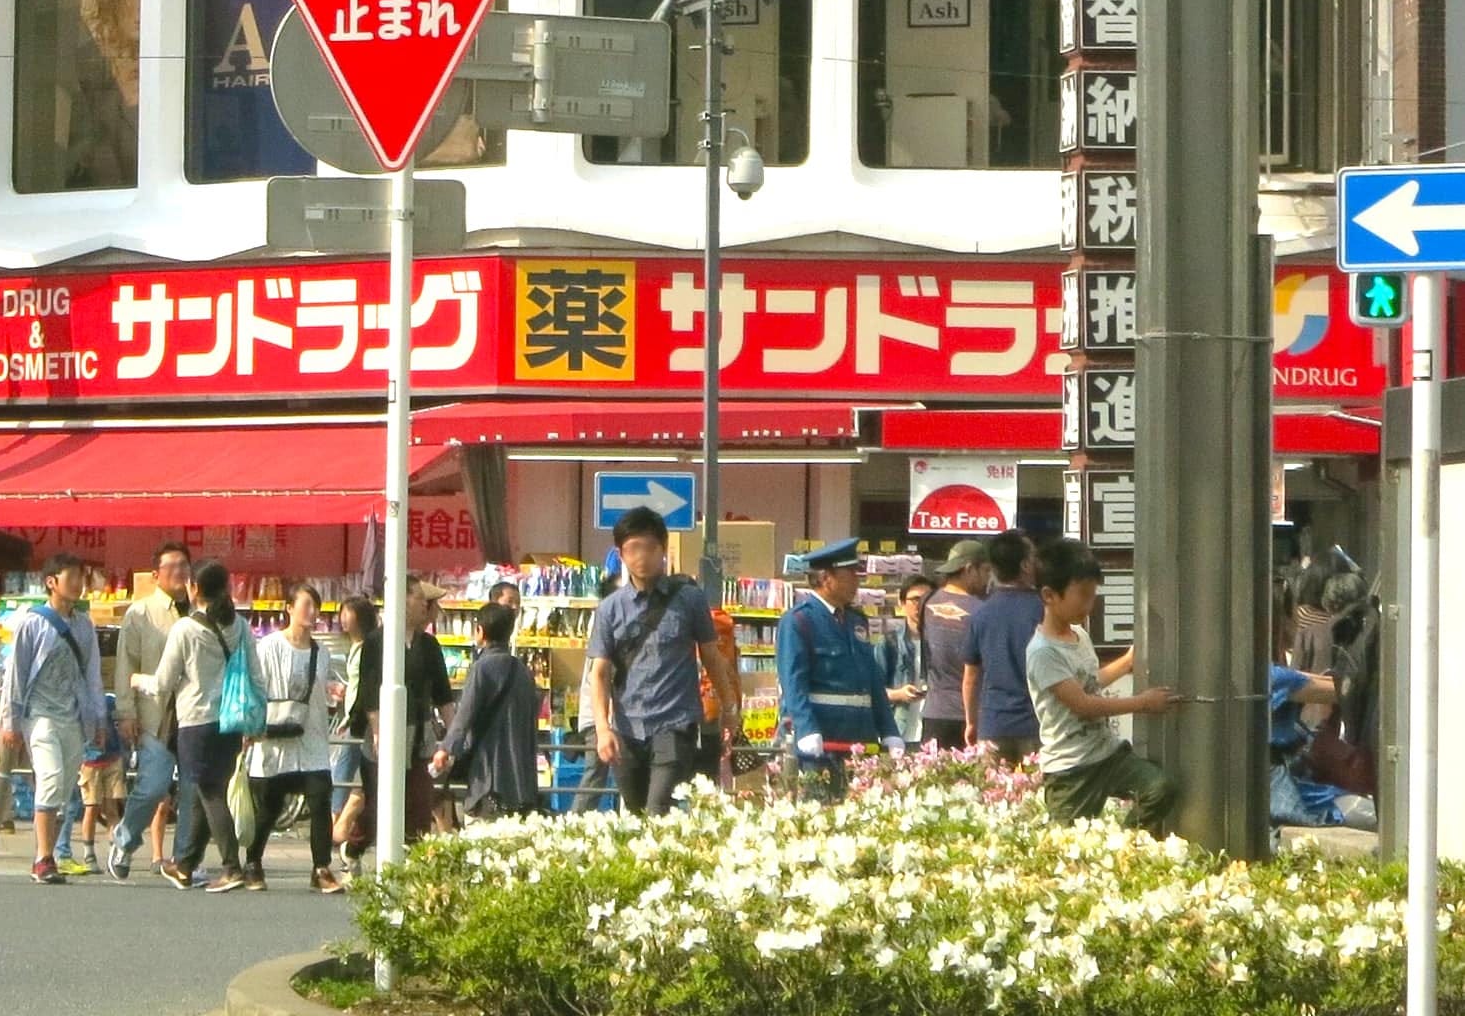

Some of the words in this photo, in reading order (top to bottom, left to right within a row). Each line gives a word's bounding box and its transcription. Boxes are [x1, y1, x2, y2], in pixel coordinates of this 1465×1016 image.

[918, 0, 961, 21] Ash
[2, 288, 71, 319] DRUG
[111, 270, 483, 380] サンドラッグ
[524, 269, 629, 372] 薬
[660, 271, 1071, 377] サンドラ
[28, 323, 46, 350] &
[1273, 368, 1358, 387] NDRUG
[918, 511, 952, 529] Tax
[956, 512, 999, 529] Free
